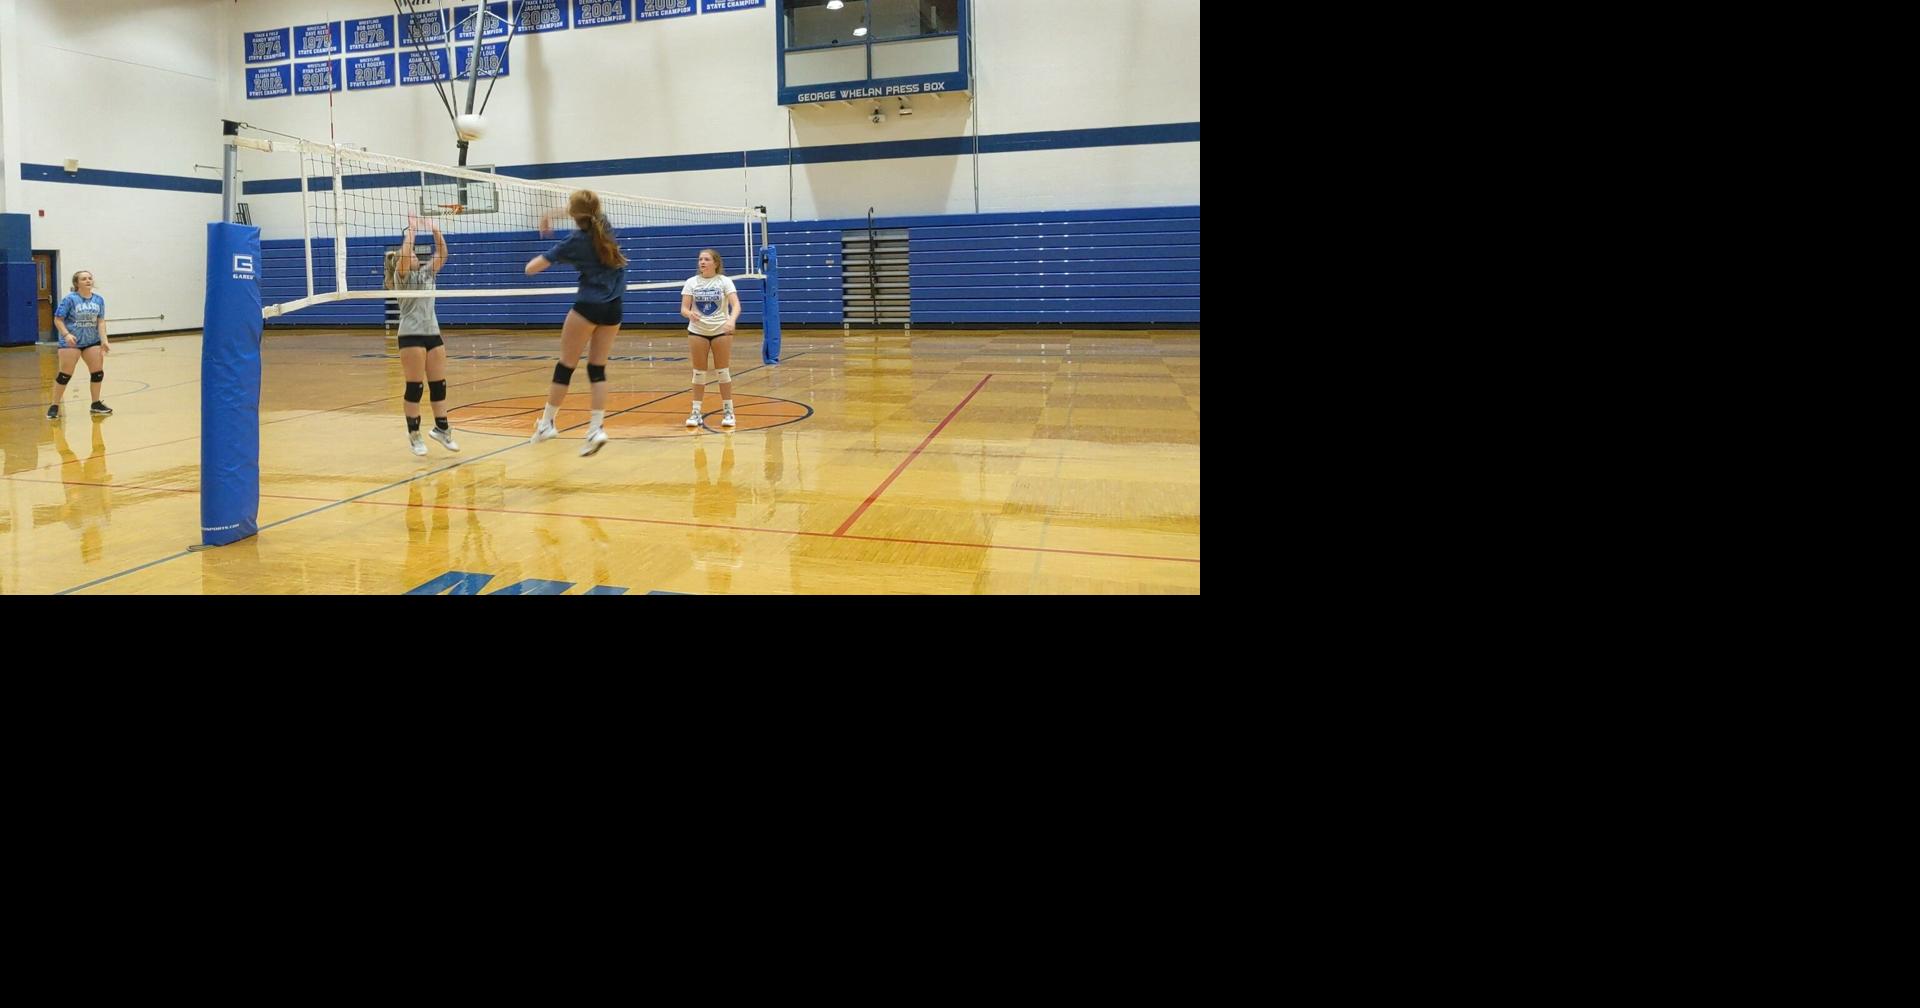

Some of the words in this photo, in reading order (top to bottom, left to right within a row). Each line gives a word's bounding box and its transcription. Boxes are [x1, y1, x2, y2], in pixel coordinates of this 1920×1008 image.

[582, 1, 623, 20] 2004
[660, 7, 691, 16] CHAMPION
[726, 0, 760, 8] CHAMPION
[521, 8, 561, 26] 2003
[597, 15, 626, 23] CHAMPION
[535, 22, 564, 30] CHAMPION
[354, 28, 385, 44] 1978
[253, 41, 281, 56] 1974
[302, 71, 333, 87] 2014
[355, 66, 386, 82] 2014
[253, 77, 284, 92] 2012
[797, 93, 837, 103] GEORGE
[840, 87, 882, 98] WHELAN
[885, 83, 920, 96] PRESS
[923, 82, 945, 92] BOX
